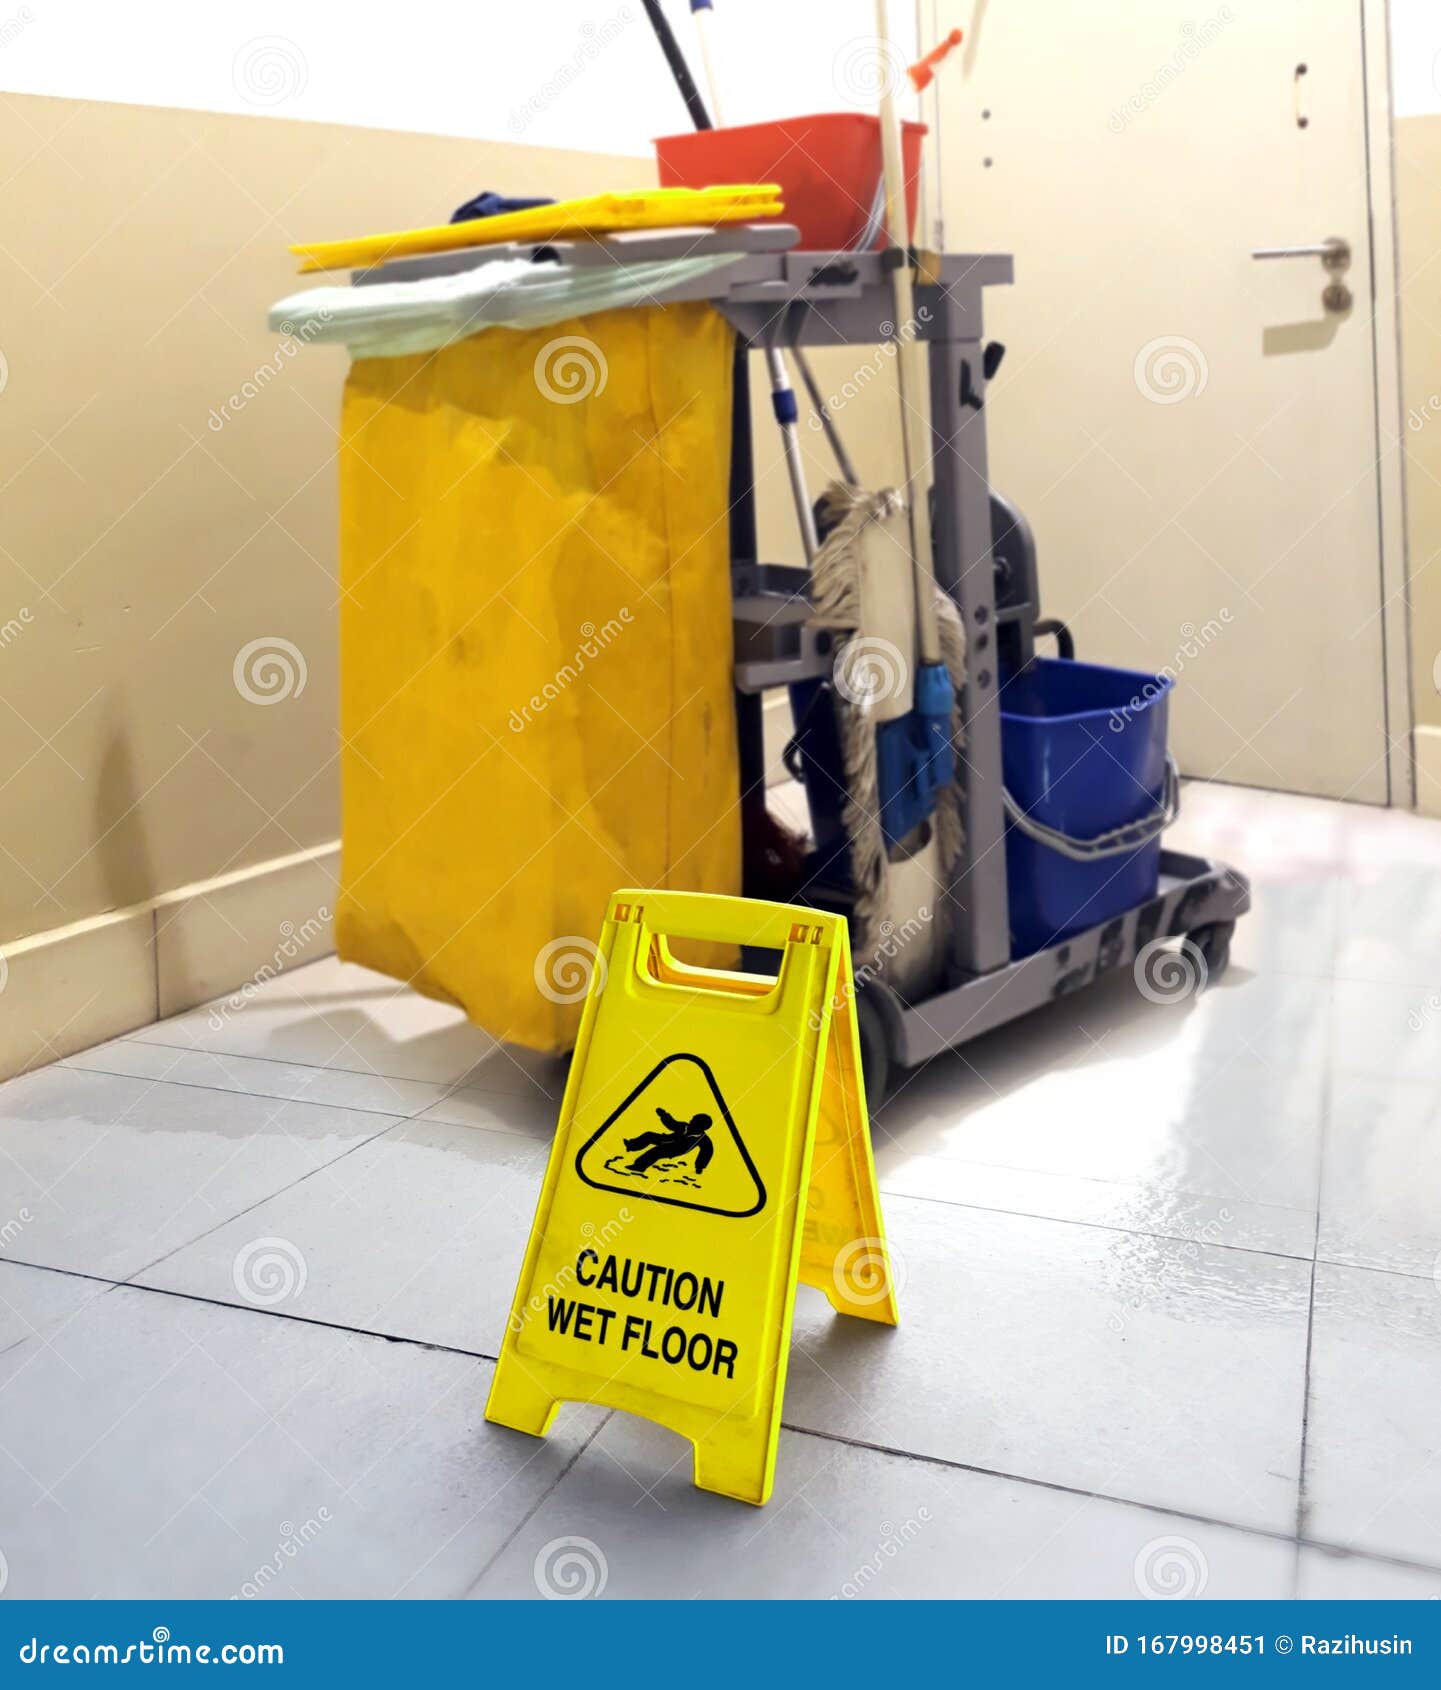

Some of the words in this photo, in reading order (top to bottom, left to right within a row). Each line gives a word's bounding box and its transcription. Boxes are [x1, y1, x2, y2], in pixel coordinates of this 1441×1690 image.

[576, 1248, 725, 1318] CAUTION
[548, 1295, 616, 1345] WET
[621, 1315, 739, 1380] FLOOR
